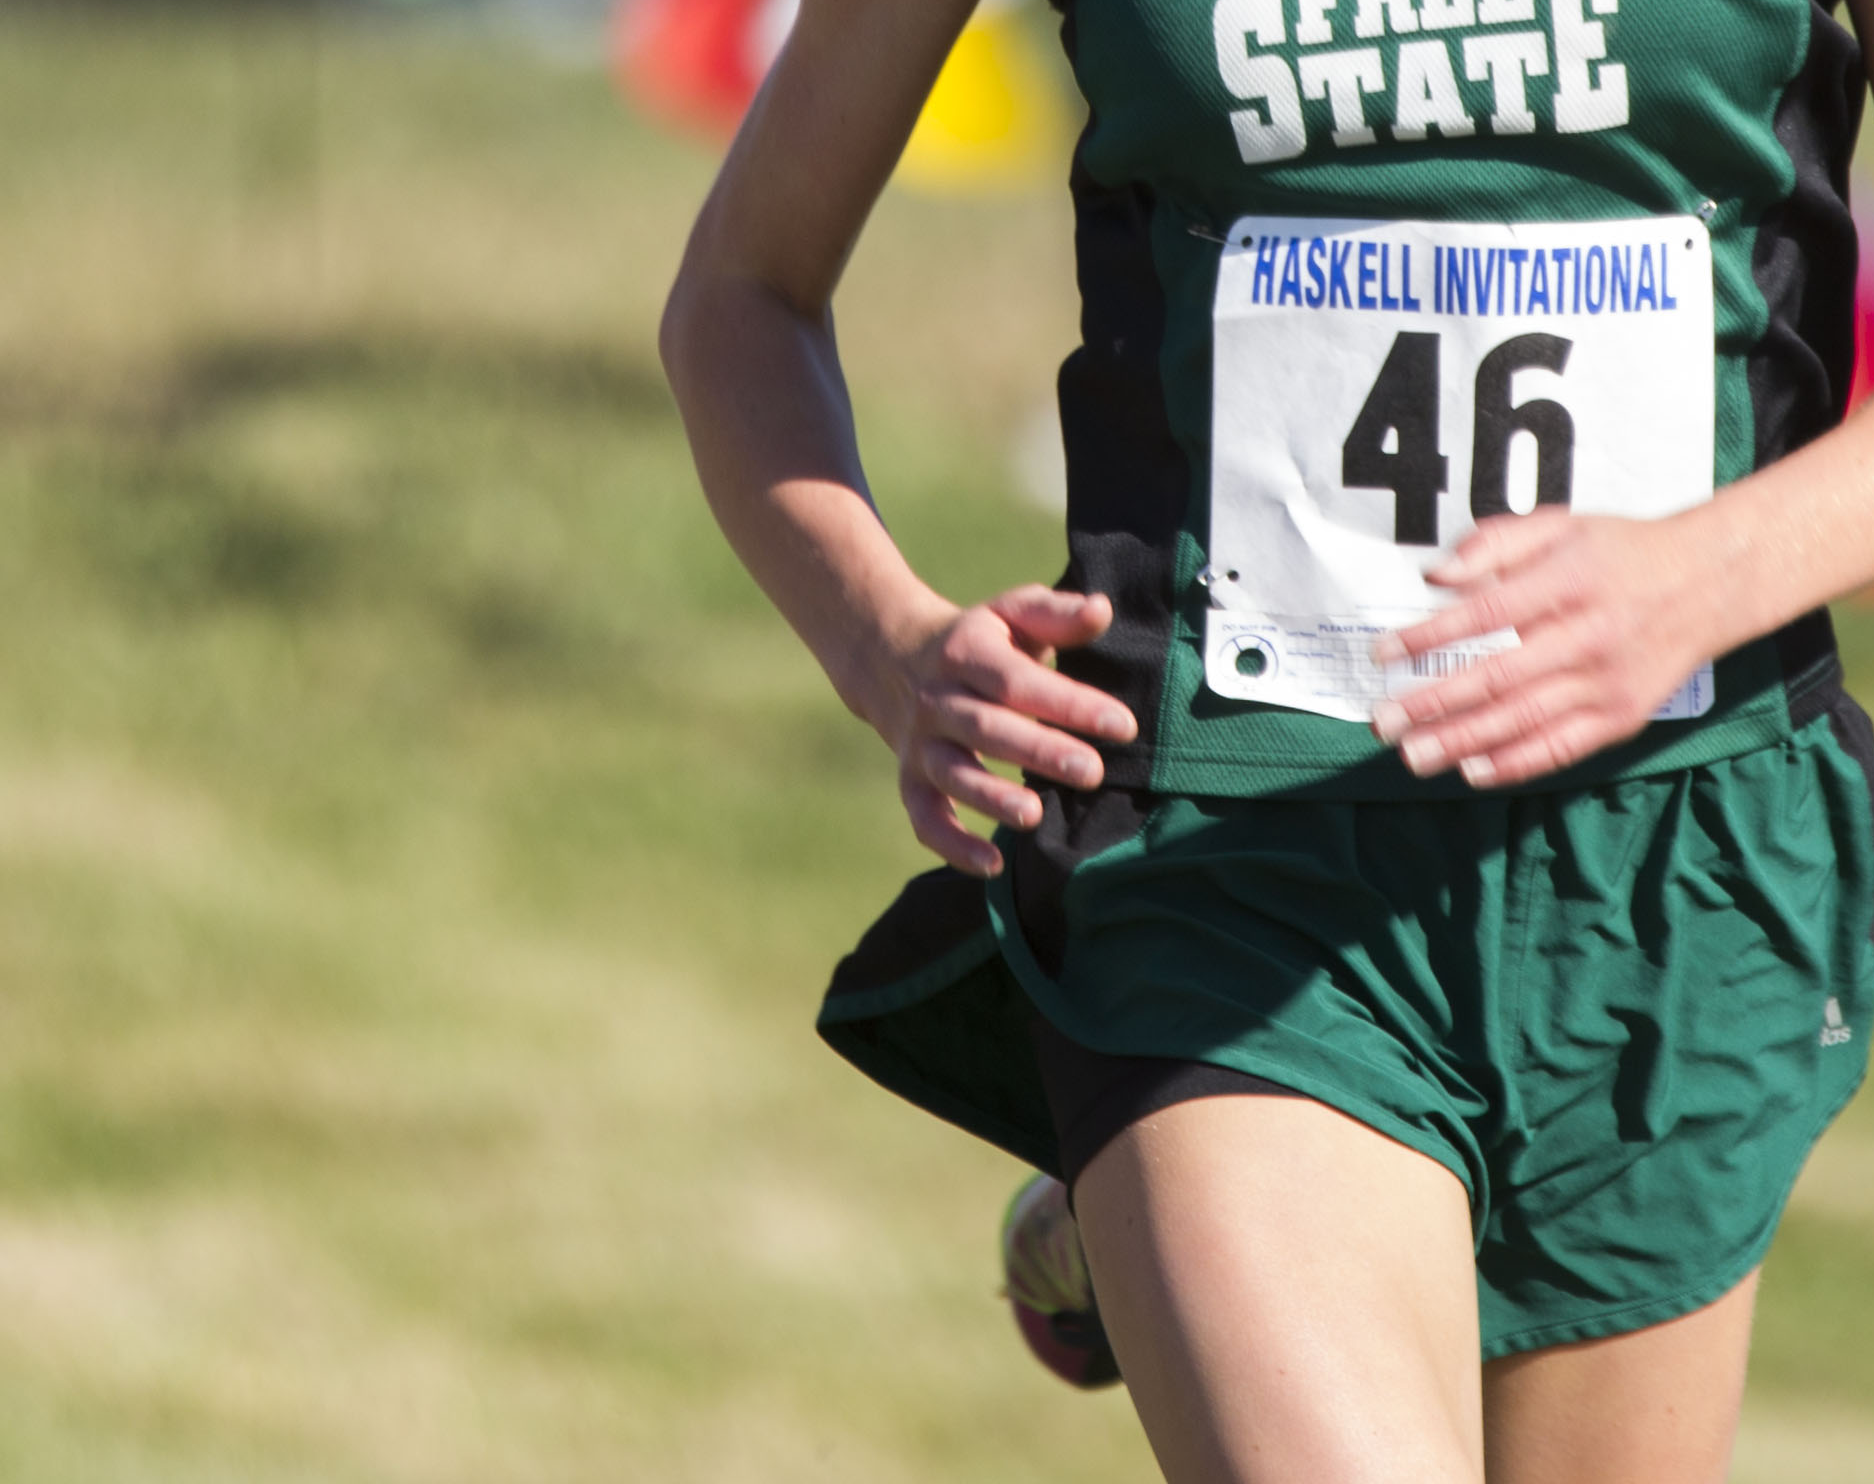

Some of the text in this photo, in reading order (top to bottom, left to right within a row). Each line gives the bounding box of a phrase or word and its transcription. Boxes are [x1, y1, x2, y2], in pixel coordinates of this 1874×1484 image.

[1251, 235, 1678, 316] HASKELL INVITATIONAL
[1341, 330, 1576, 547] 46
